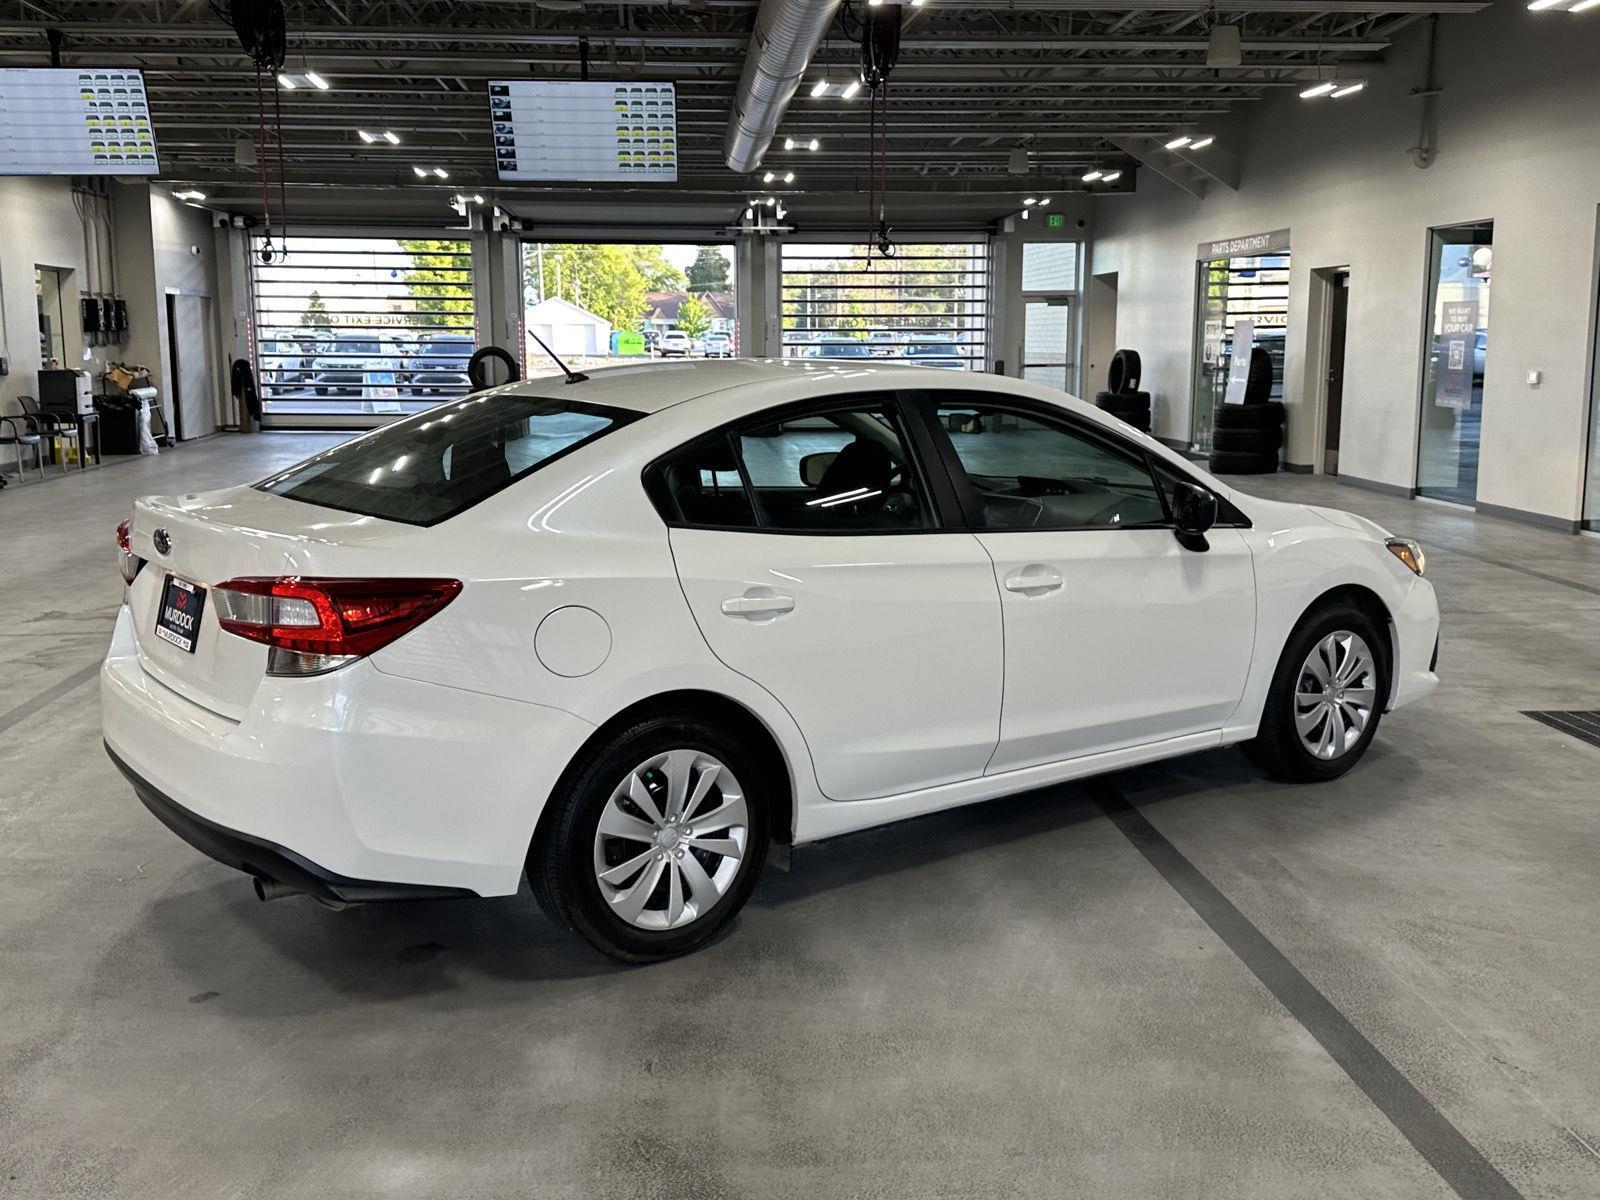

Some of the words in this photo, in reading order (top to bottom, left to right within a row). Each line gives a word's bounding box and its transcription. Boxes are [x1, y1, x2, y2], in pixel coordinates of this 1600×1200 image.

[1211, 240, 1230, 255] PARTS
[1230, 235, 1271, 253] DEPARTMENT
[1444, 324, 1460, 333] YOUR
[1460, 323, 1474, 333] CAR
[164, 605, 194, 631] MURDOCK
